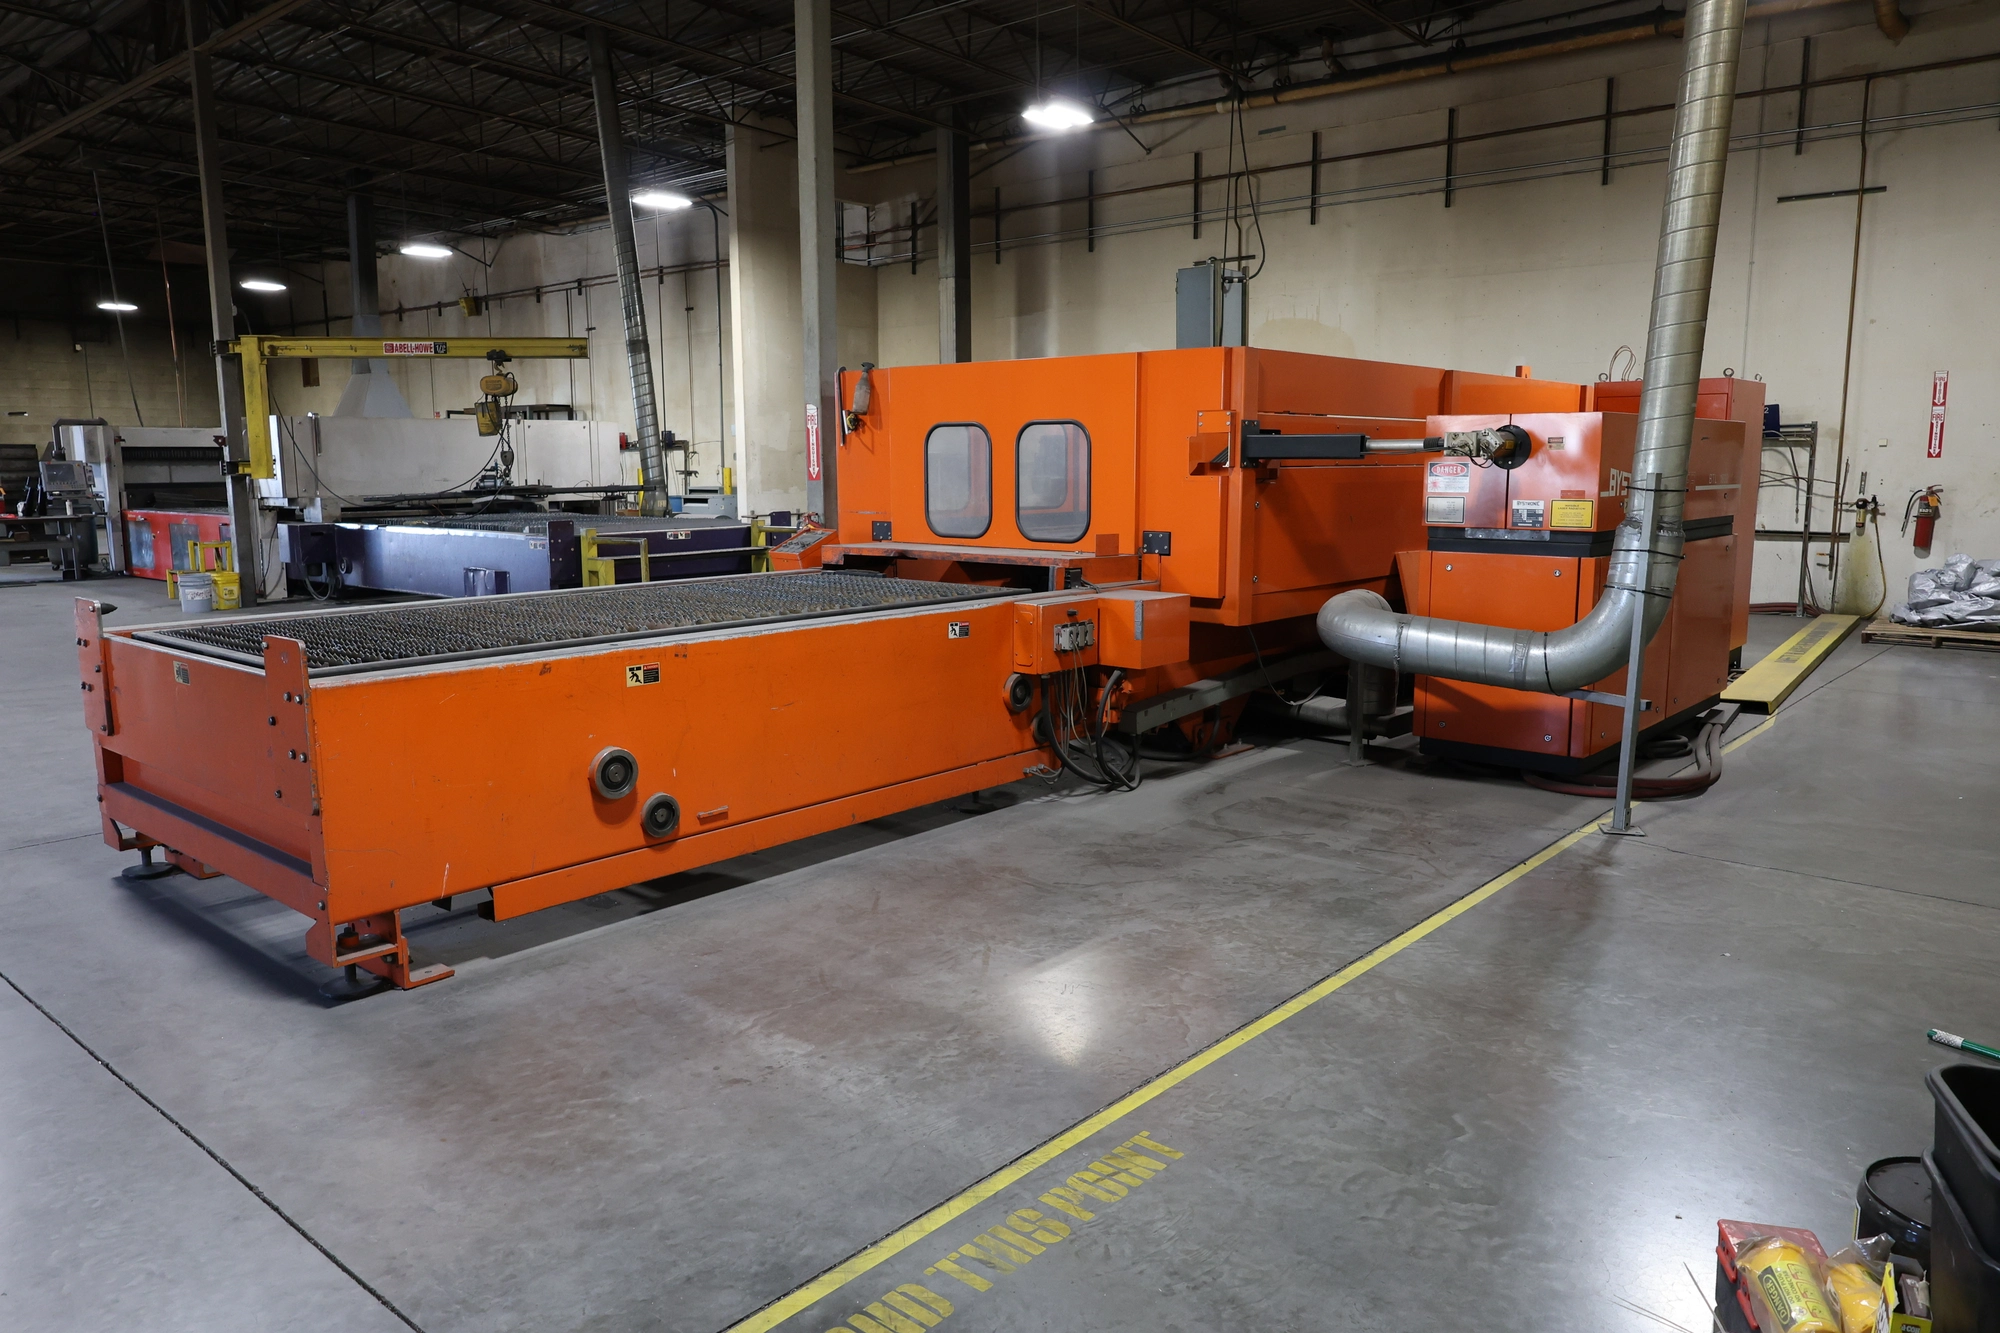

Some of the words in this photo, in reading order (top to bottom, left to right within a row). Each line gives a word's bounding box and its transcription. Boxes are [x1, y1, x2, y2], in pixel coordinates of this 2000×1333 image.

[394, 343, 434, 354] ABELL-HOWE
[807, 414, 817, 426] FIRE
[1932, 413, 1944, 422] FIRE
[1436, 466, 1462, 474] DANGER
[923, 1208, 1072, 1293] THIS
[1038, 1130, 1185, 1222] POINT
[1766, 1279, 1788, 1319] DANGER
